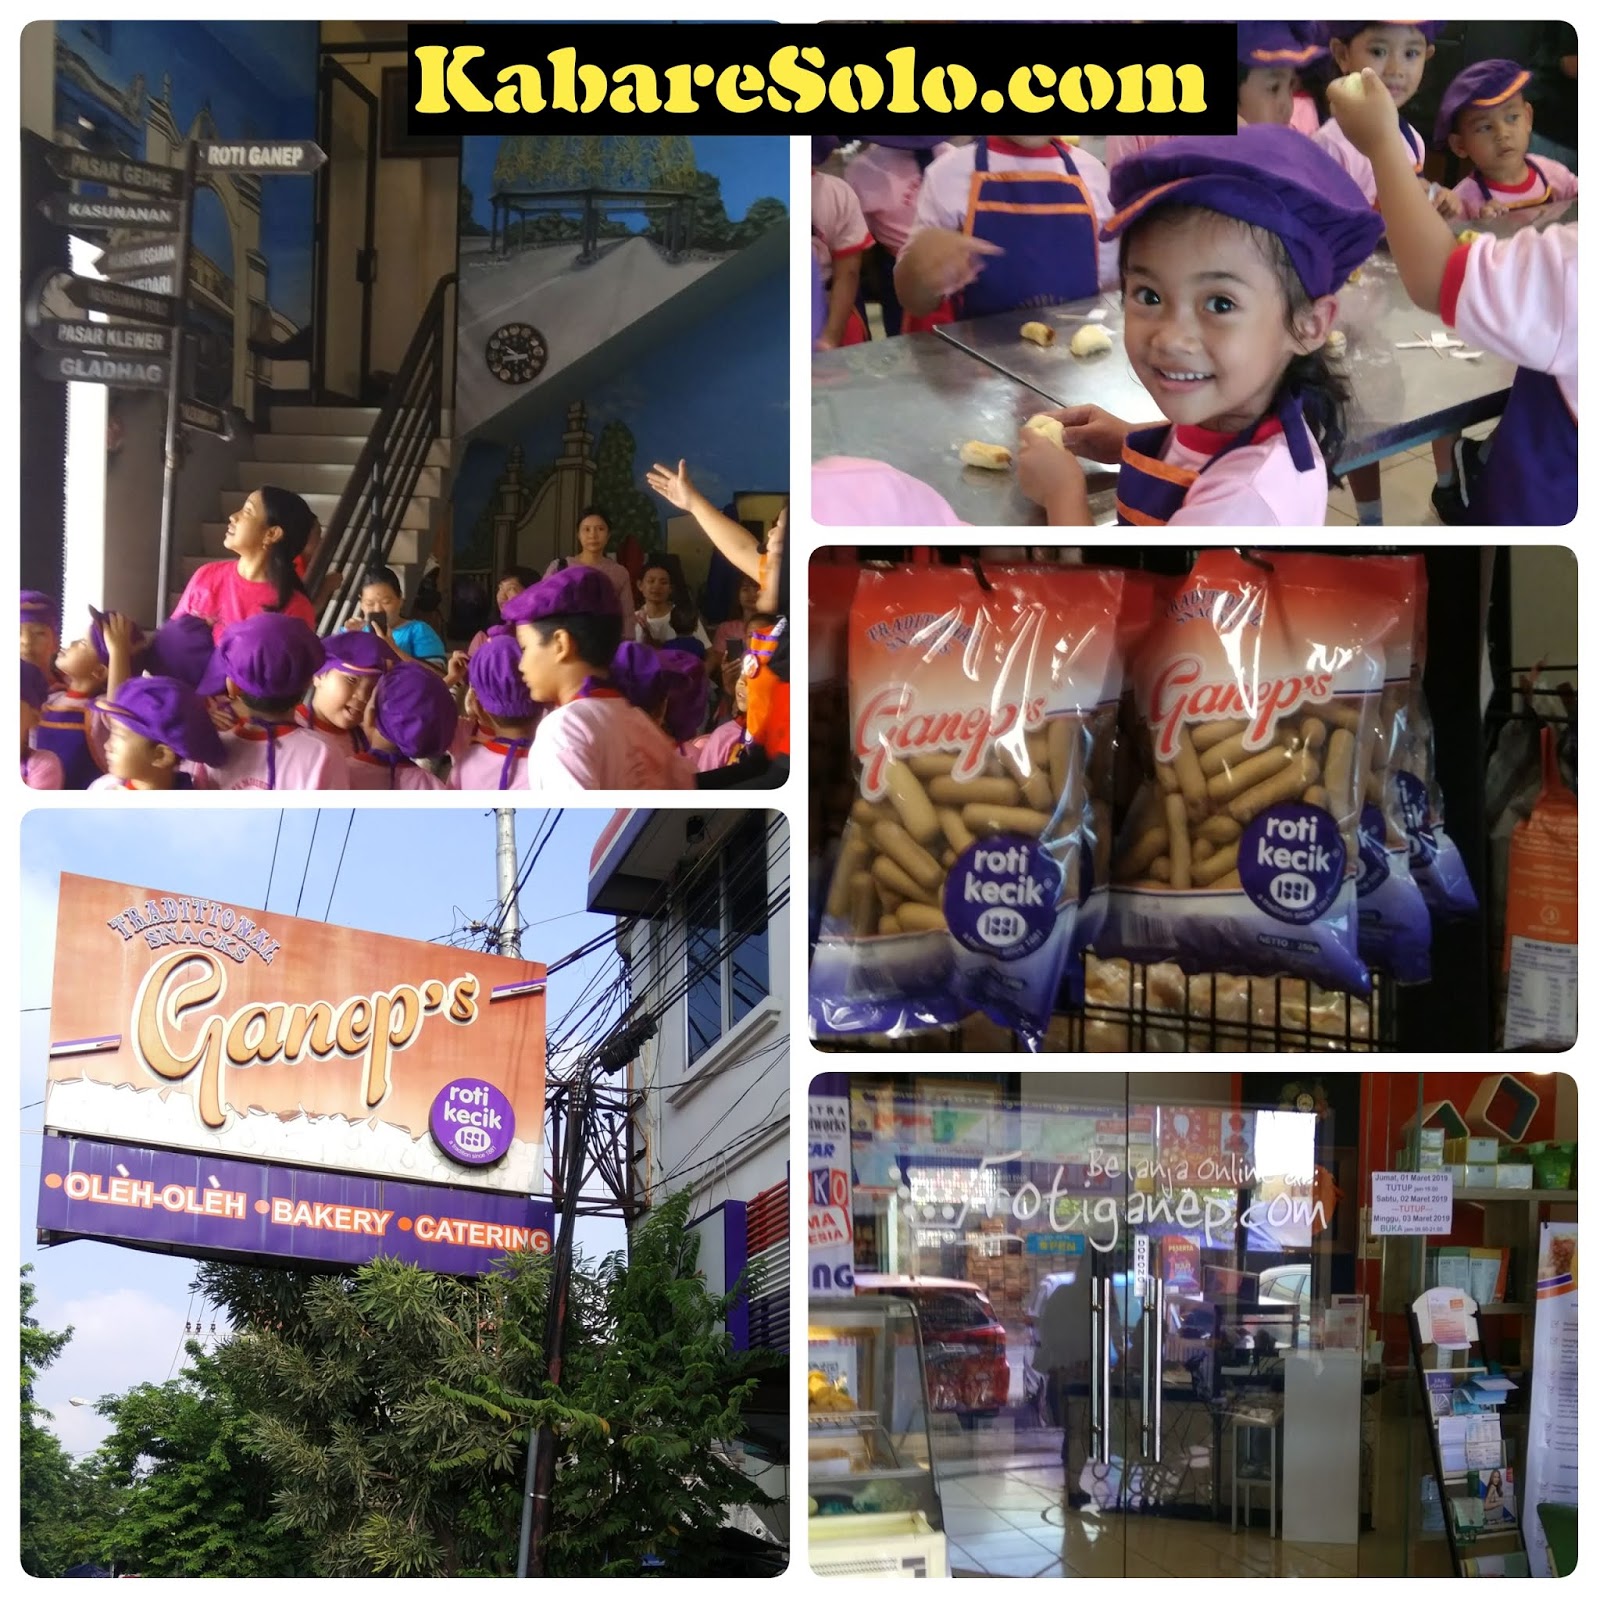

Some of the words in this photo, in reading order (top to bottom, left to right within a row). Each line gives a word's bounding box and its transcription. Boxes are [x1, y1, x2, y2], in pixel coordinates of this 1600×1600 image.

[208, 147, 244, 165] ROTI
[249, 147, 303, 166] GANEP
[68, 203, 171, 222] KASUNANAN
[58, 324, 104, 345] PASAR
[106, 326, 162, 350] KLEWER
[60, 357, 162, 382] GLADHAG
[1151, 657, 1333, 756] Ganep's
[1266, 815, 1318, 842] roti
[974, 845, 1029, 874] roti
[1257, 837, 1331, 872] kecik
[964, 872, 1044, 906] kecik
[107, 897, 281, 966] TRADITIONAL
[145, 925, 250, 963] SNACKS
[132, 950, 481, 1132] Ganep's
[449, 1086, 490, 1107] roti
[443, 1100, 502, 1130] kecik
[808, 1141, 836, 1158] AR
[808, 1170, 847, 1206] KO
[1375, 1175, 1399, 1183] Jumat,
[984, 1165, 1328, 1253] rotiganep.com
[1376, 1195, 1399, 1203] Sabtu,
[272, 1198, 395, 1236] BAKERY
[415, 1216, 551, 1253] CATERING
[1374, 1215, 1401, 1223] Minggu,
